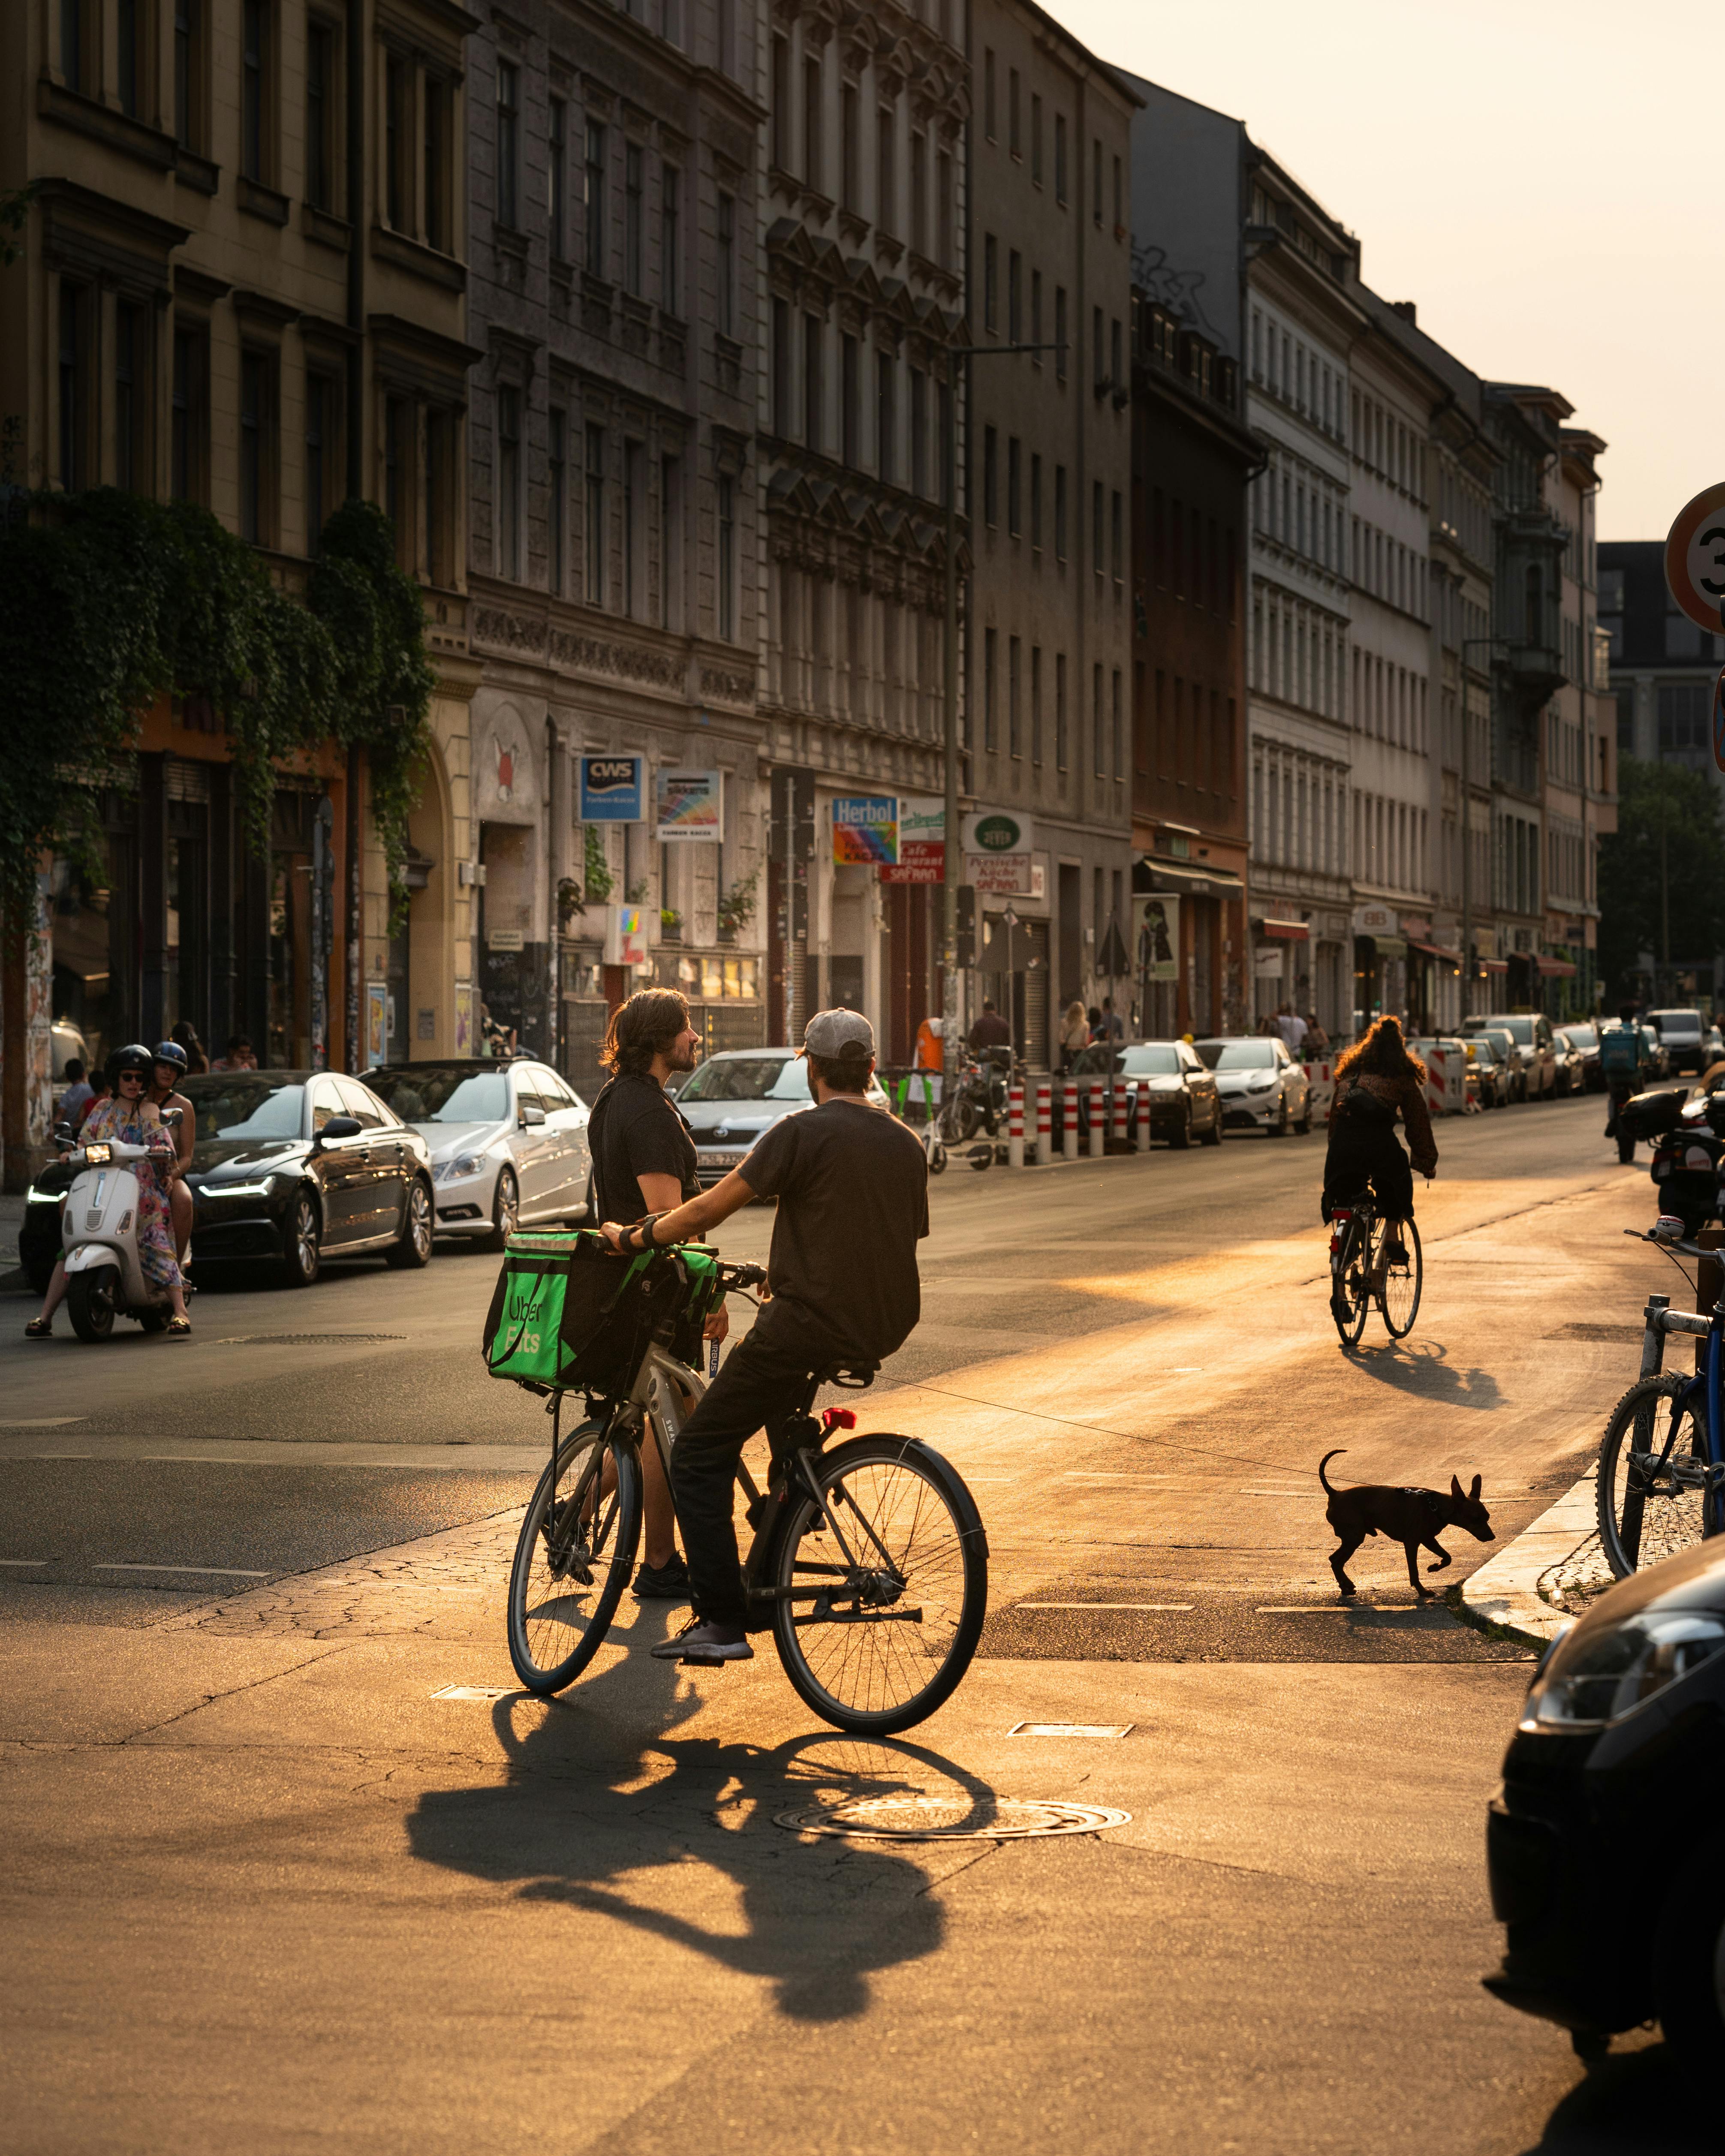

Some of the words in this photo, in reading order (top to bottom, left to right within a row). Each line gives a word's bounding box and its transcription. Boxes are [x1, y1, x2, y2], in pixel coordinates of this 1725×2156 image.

[1699, 527, 1725, 595] 3
[590, 762, 632, 778] CWS
[838, 800, 892, 822] Herbol
[509, 1296, 542, 1322] Uber
